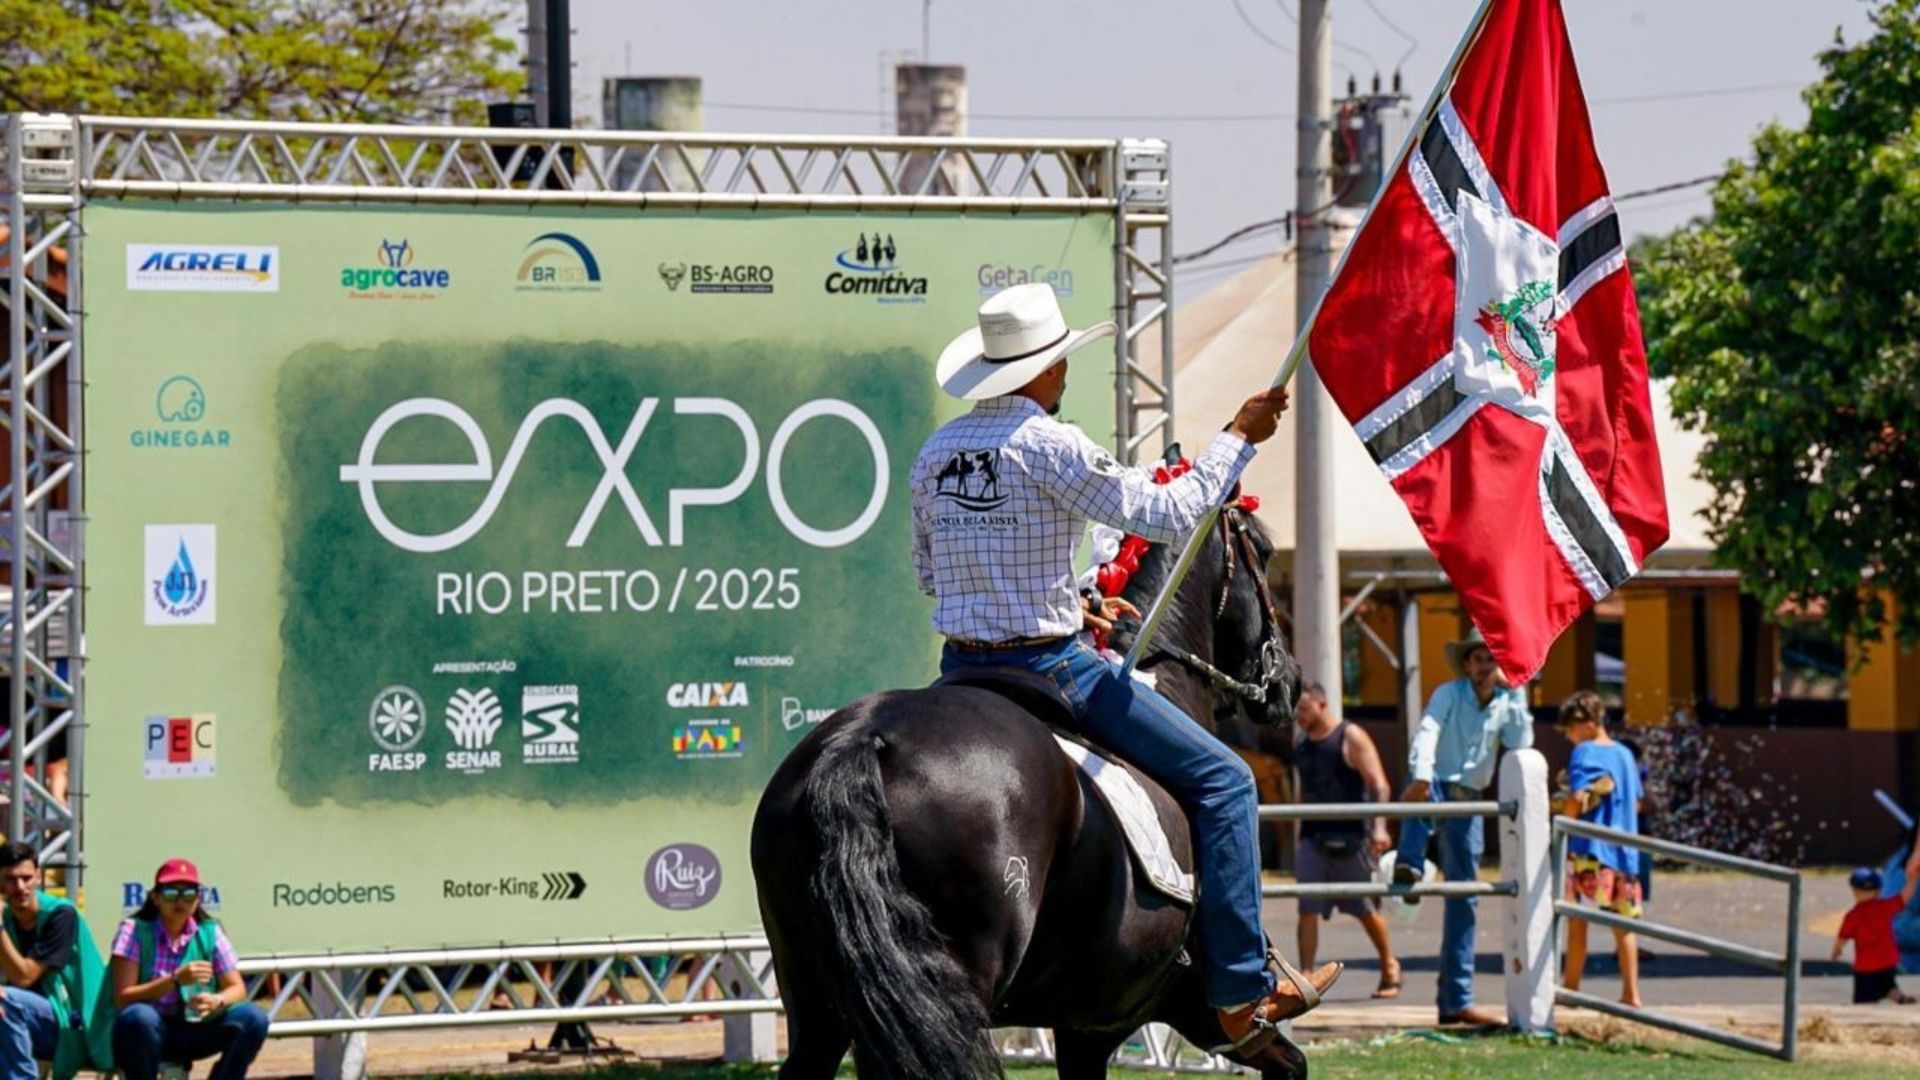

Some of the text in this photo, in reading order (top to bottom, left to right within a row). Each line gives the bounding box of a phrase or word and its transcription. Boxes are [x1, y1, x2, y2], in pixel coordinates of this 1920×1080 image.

[138, 252, 272, 273] AGRELI
[341, 267, 450, 291] agrocave
[691, 265, 774, 283] BS-AGRO
[825, 271, 928, 295] Comitiva
[130, 430, 231, 448] GINEGAR
[436, 572, 512, 614] RIO
[522, 570, 661, 613] PRETO
[694, 567, 801, 611] 2025
[666, 682, 749, 708] CAIXA
[148, 720, 212, 752] PEC
[446, 751, 502, 769] SENAR
[523, 744, 579, 757] RURAL
[369, 753, 427, 771] FAESP
[273, 882, 396, 907] Rodobens
[443, 877, 539, 899] Rotor-King
